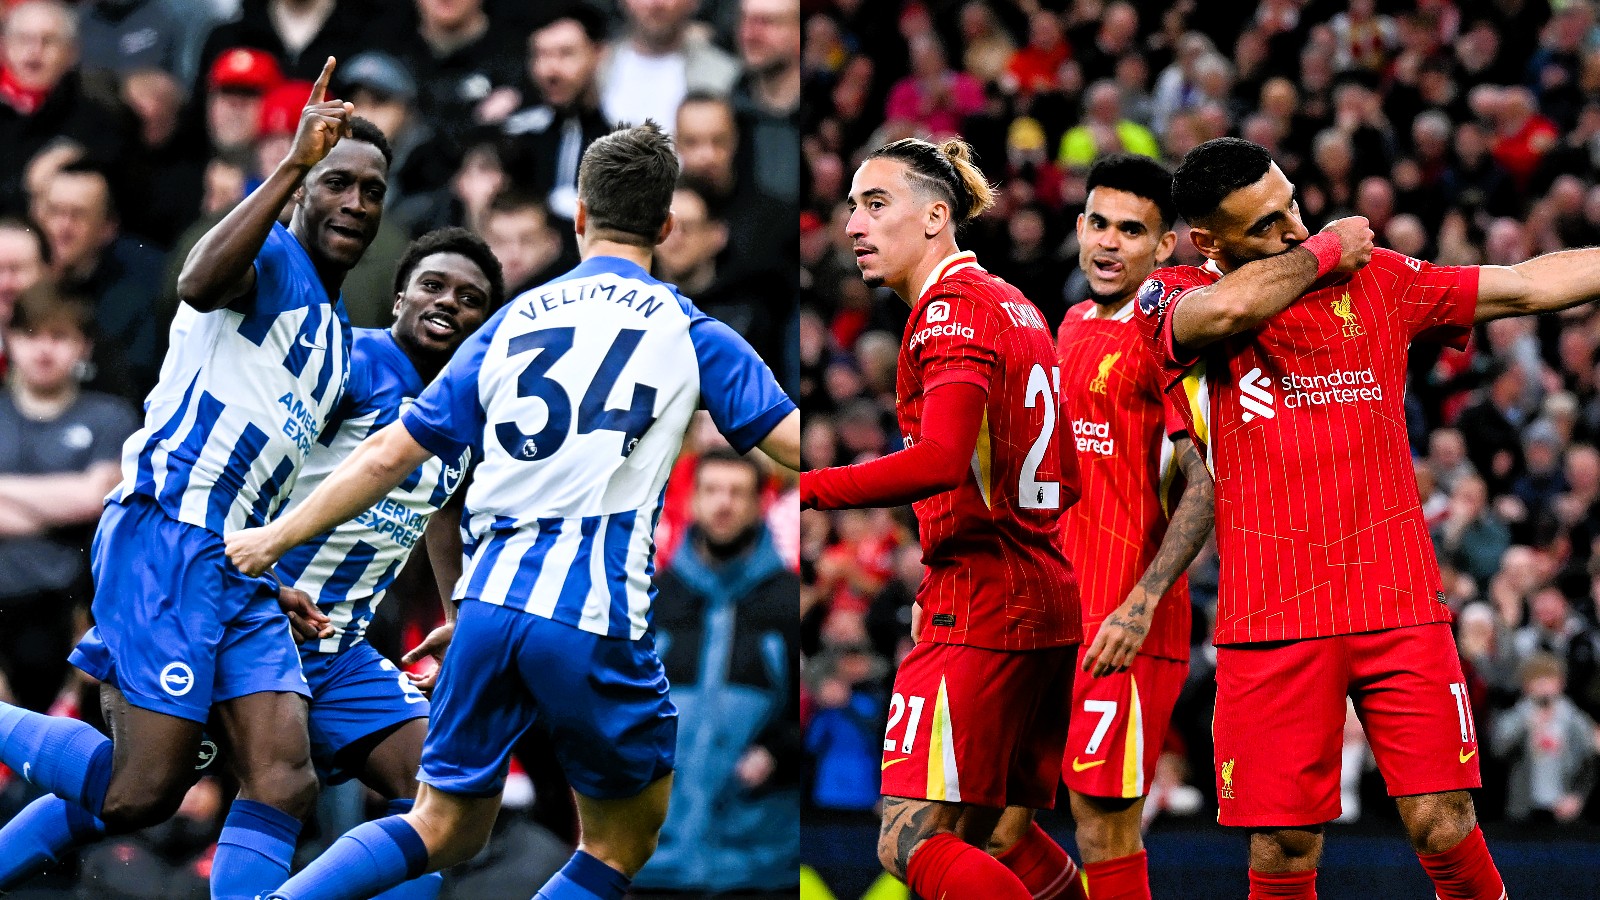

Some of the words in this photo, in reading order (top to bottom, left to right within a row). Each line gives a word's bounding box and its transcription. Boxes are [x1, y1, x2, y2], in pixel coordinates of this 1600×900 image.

[519, 282, 665, 321] VELTMAN
[909, 322, 975, 350] Expedia
[494, 326, 658, 461] 34
[1281, 367, 1375, 391] standard
[1284, 384, 1383, 409] chartered
[1071, 417, 1110, 438] dard
[1075, 435, 1114, 456] ered
[883, 691, 926, 755] 21
[1084, 699, 1118, 755] 7
[1449, 682, 1475, 743] 11
